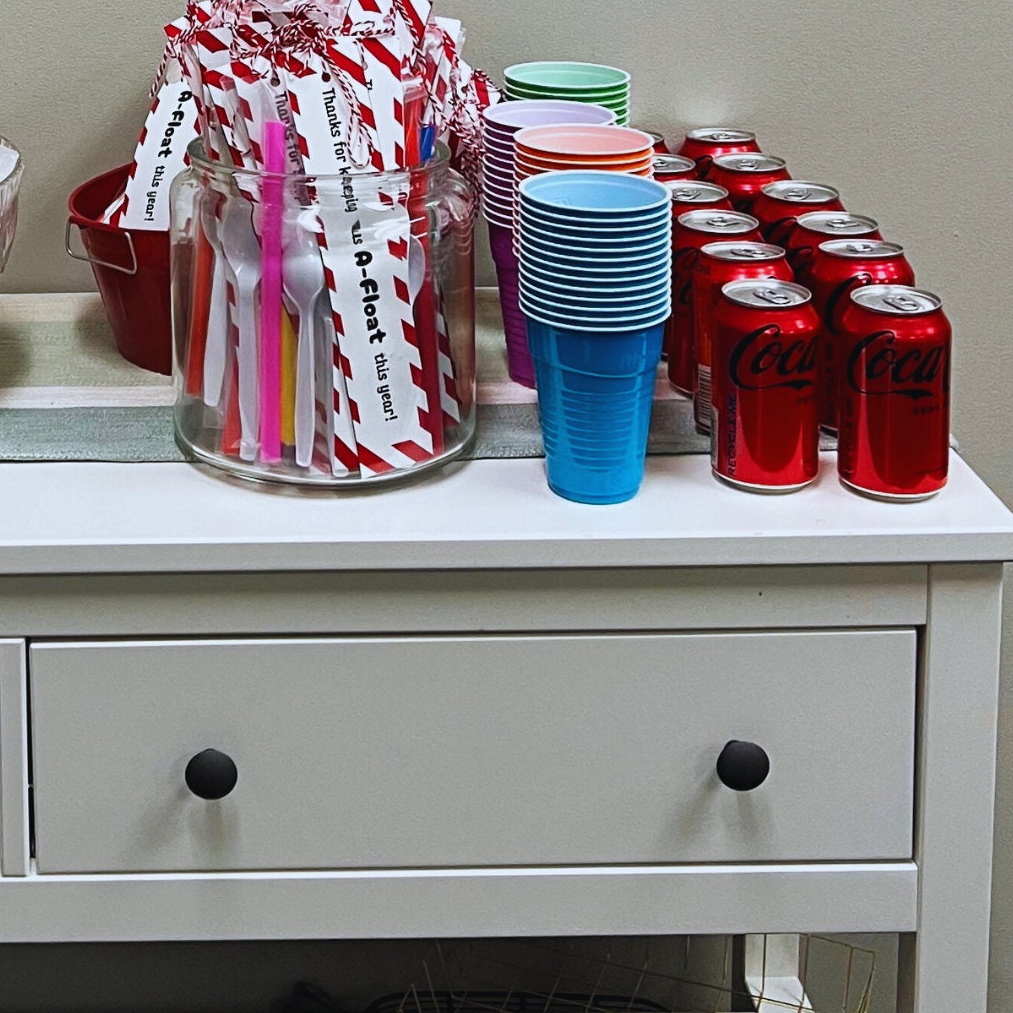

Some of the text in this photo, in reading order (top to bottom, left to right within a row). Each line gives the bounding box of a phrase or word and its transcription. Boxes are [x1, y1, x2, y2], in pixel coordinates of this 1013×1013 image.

[322, 87, 342, 137] Thanks
[144, 90, 192, 221] A-Float this year!
[334, 141, 348, 163] for
[354, 250, 387, 345] A-Float
[374, 352, 388, 381] this
[377, 384, 398, 422] year!
